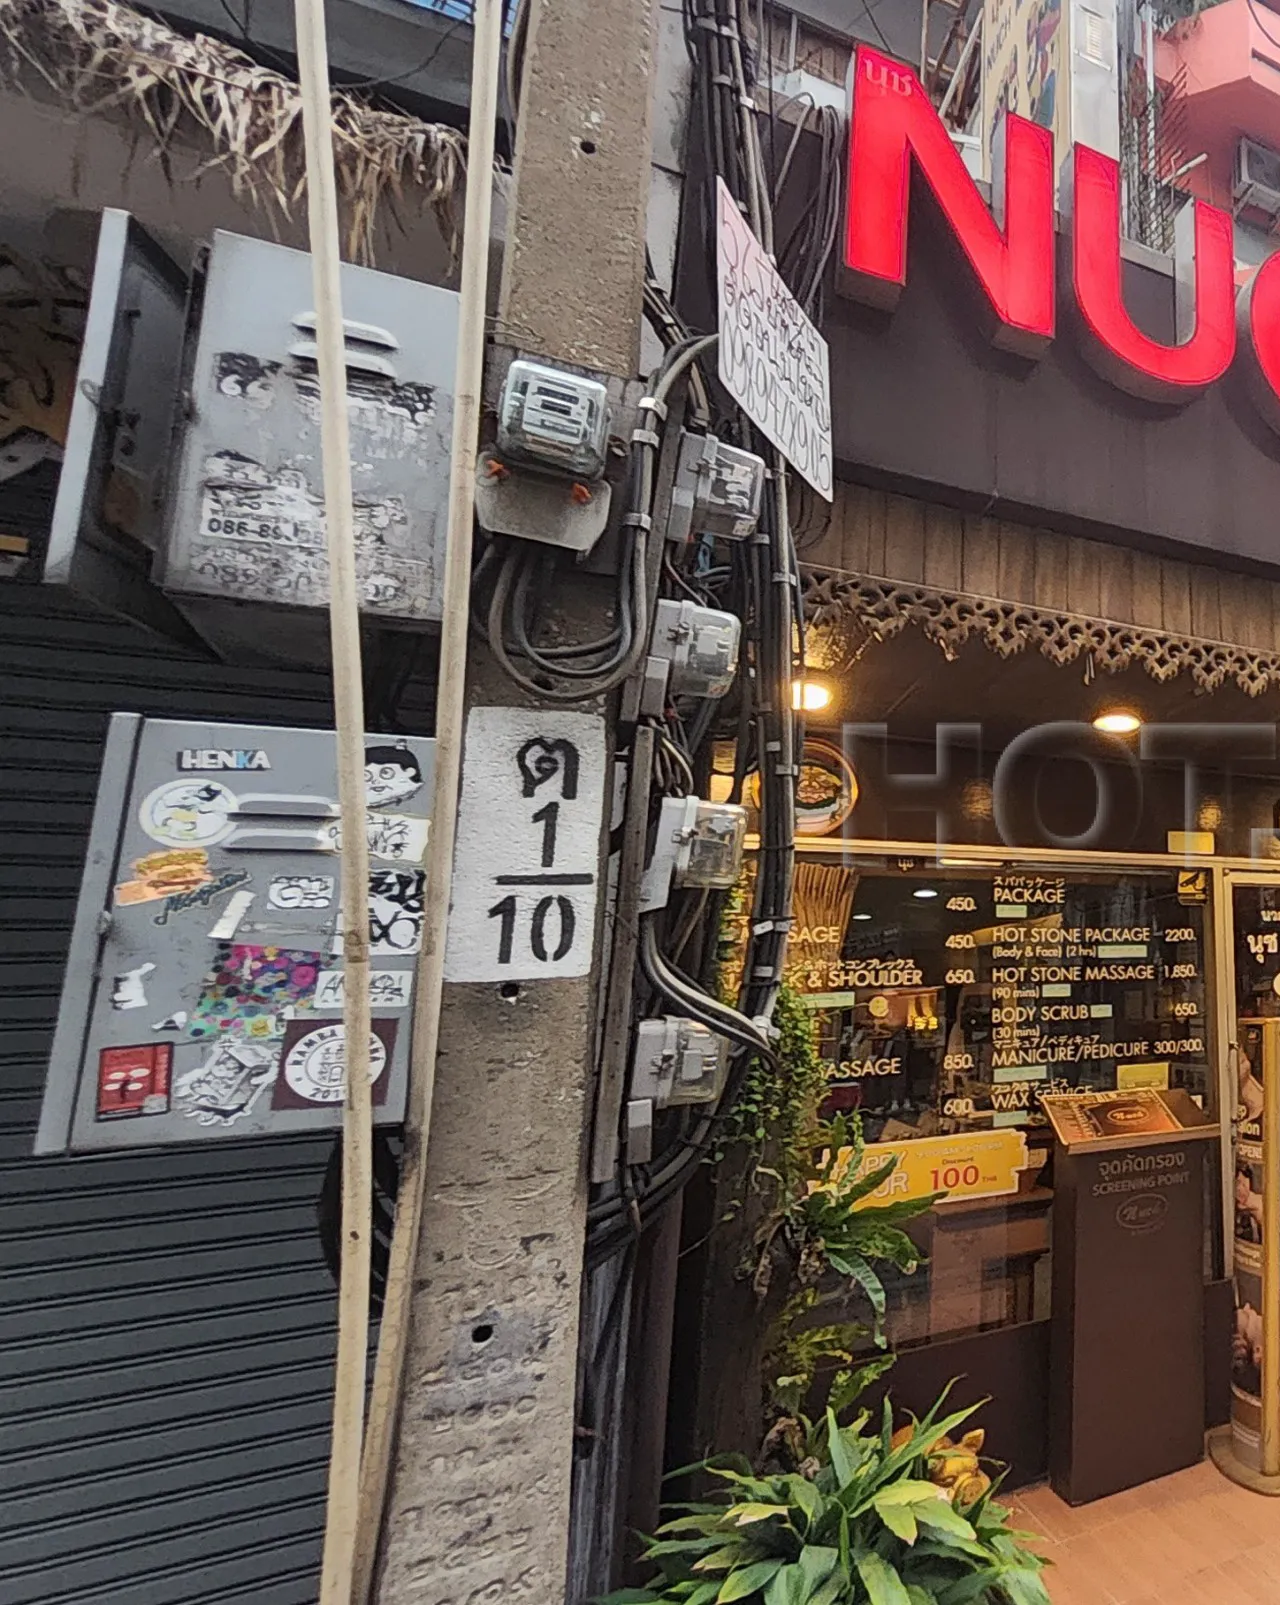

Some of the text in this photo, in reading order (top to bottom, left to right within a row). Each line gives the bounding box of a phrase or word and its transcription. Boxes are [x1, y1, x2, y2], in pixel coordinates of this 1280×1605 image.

[179, 749, 271, 771] HENKA
[531, 801, 560, 868] 1
[993, 888, 1066, 904] PACKAGE
[488, 894, 577, 965] 10
[992, 928, 1028, 943] HOT
[1030, 927, 1082, 943] STONE
[1084, 926, 1151, 942] PACKAGE
[828, 969, 923, 988] SHOULDER
[992, 967, 1028, 984] HOT
[1030, 966, 1083, 982] STONE
[1084, 964, 1156, 981] MASSAGE
[991, 1006, 1038, 1024] BODY
[1040, 1003, 1089, 1022] SCRUB
[991, 1041, 1150, 1068] MANICURE/PEDICURE
[990, 1093, 1030, 1111] WAX
[930, 1165, 979, 1191] 100
[1100, 1153, 1185, 1181] จุดคัดกรอง
[1092, 1171, 1191, 1197] SCREENING POINT
